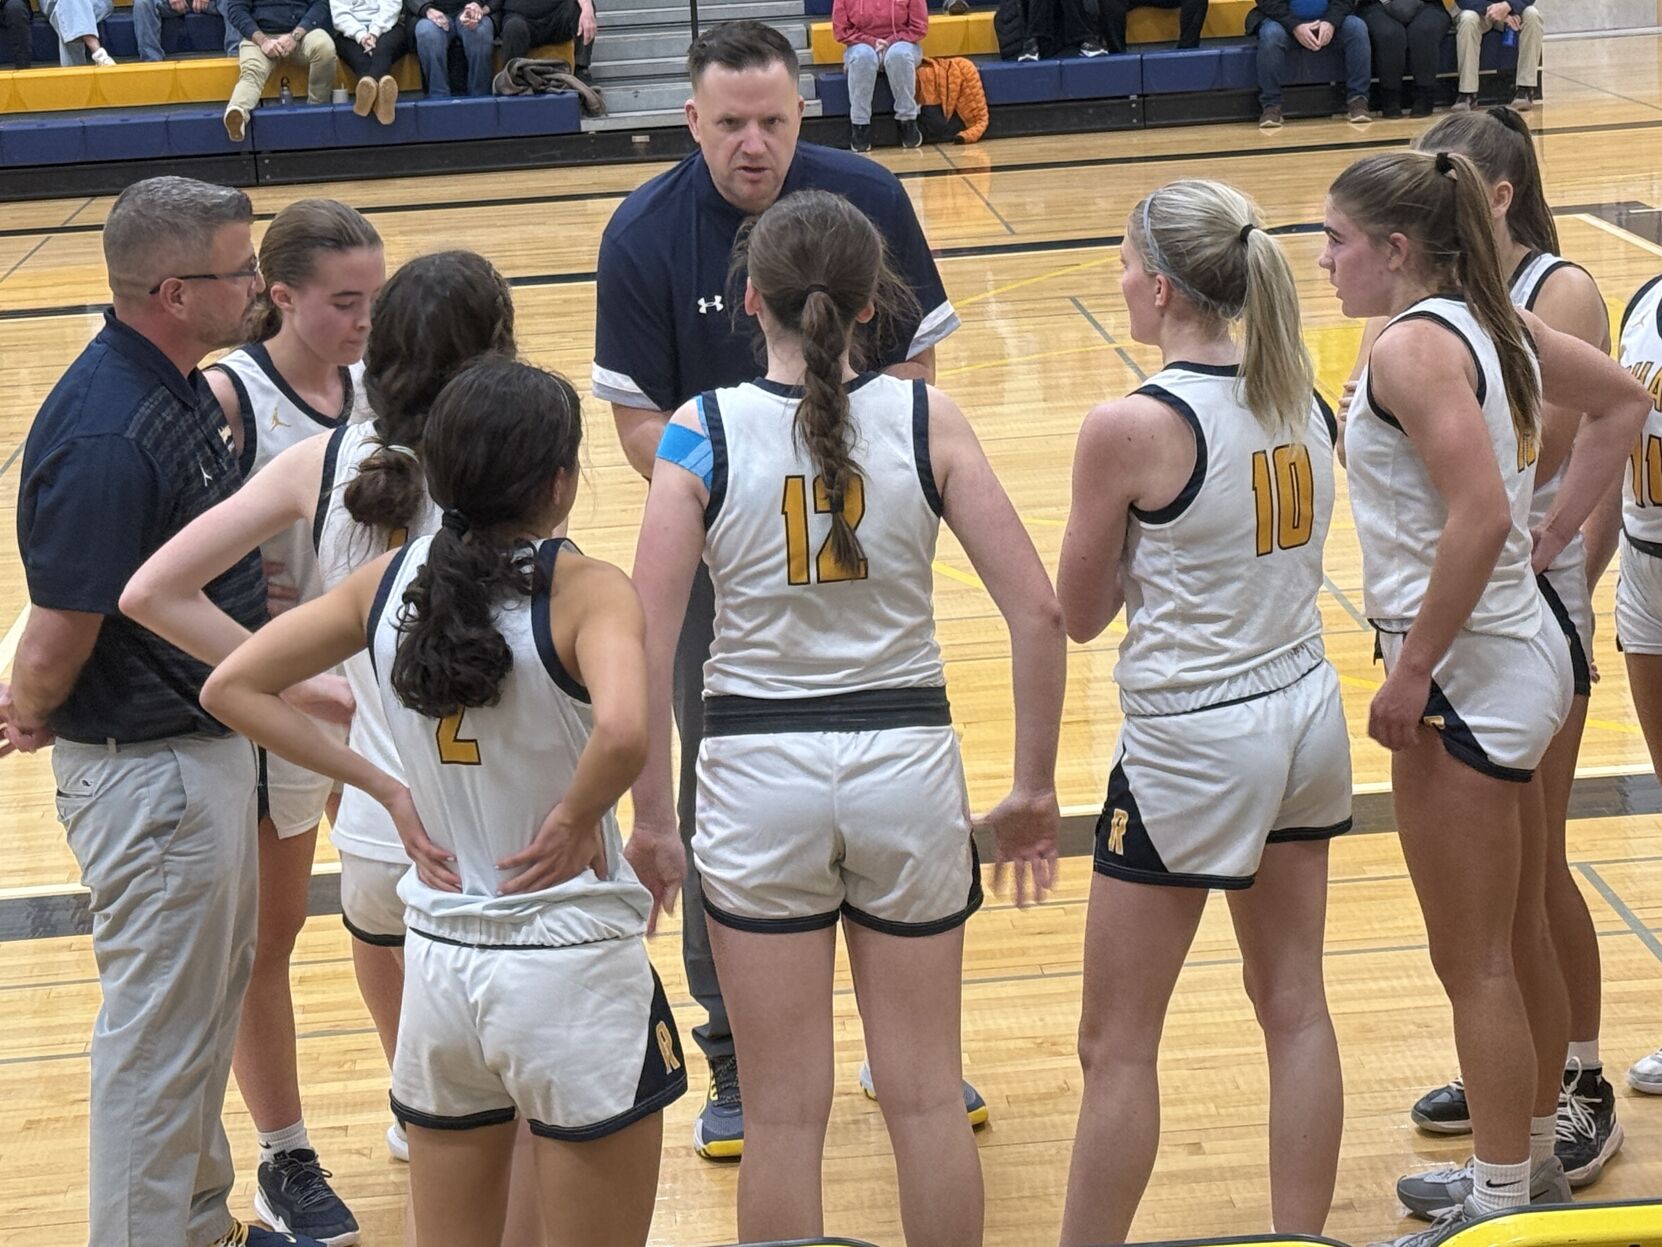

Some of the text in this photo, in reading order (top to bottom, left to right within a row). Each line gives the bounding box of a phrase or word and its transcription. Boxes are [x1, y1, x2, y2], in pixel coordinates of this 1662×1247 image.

[781, 474, 868, 585] 12
[1252, 443, 1314, 557] 10
[1108, 808, 1129, 856] R
[656, 1020, 681, 1075] R
